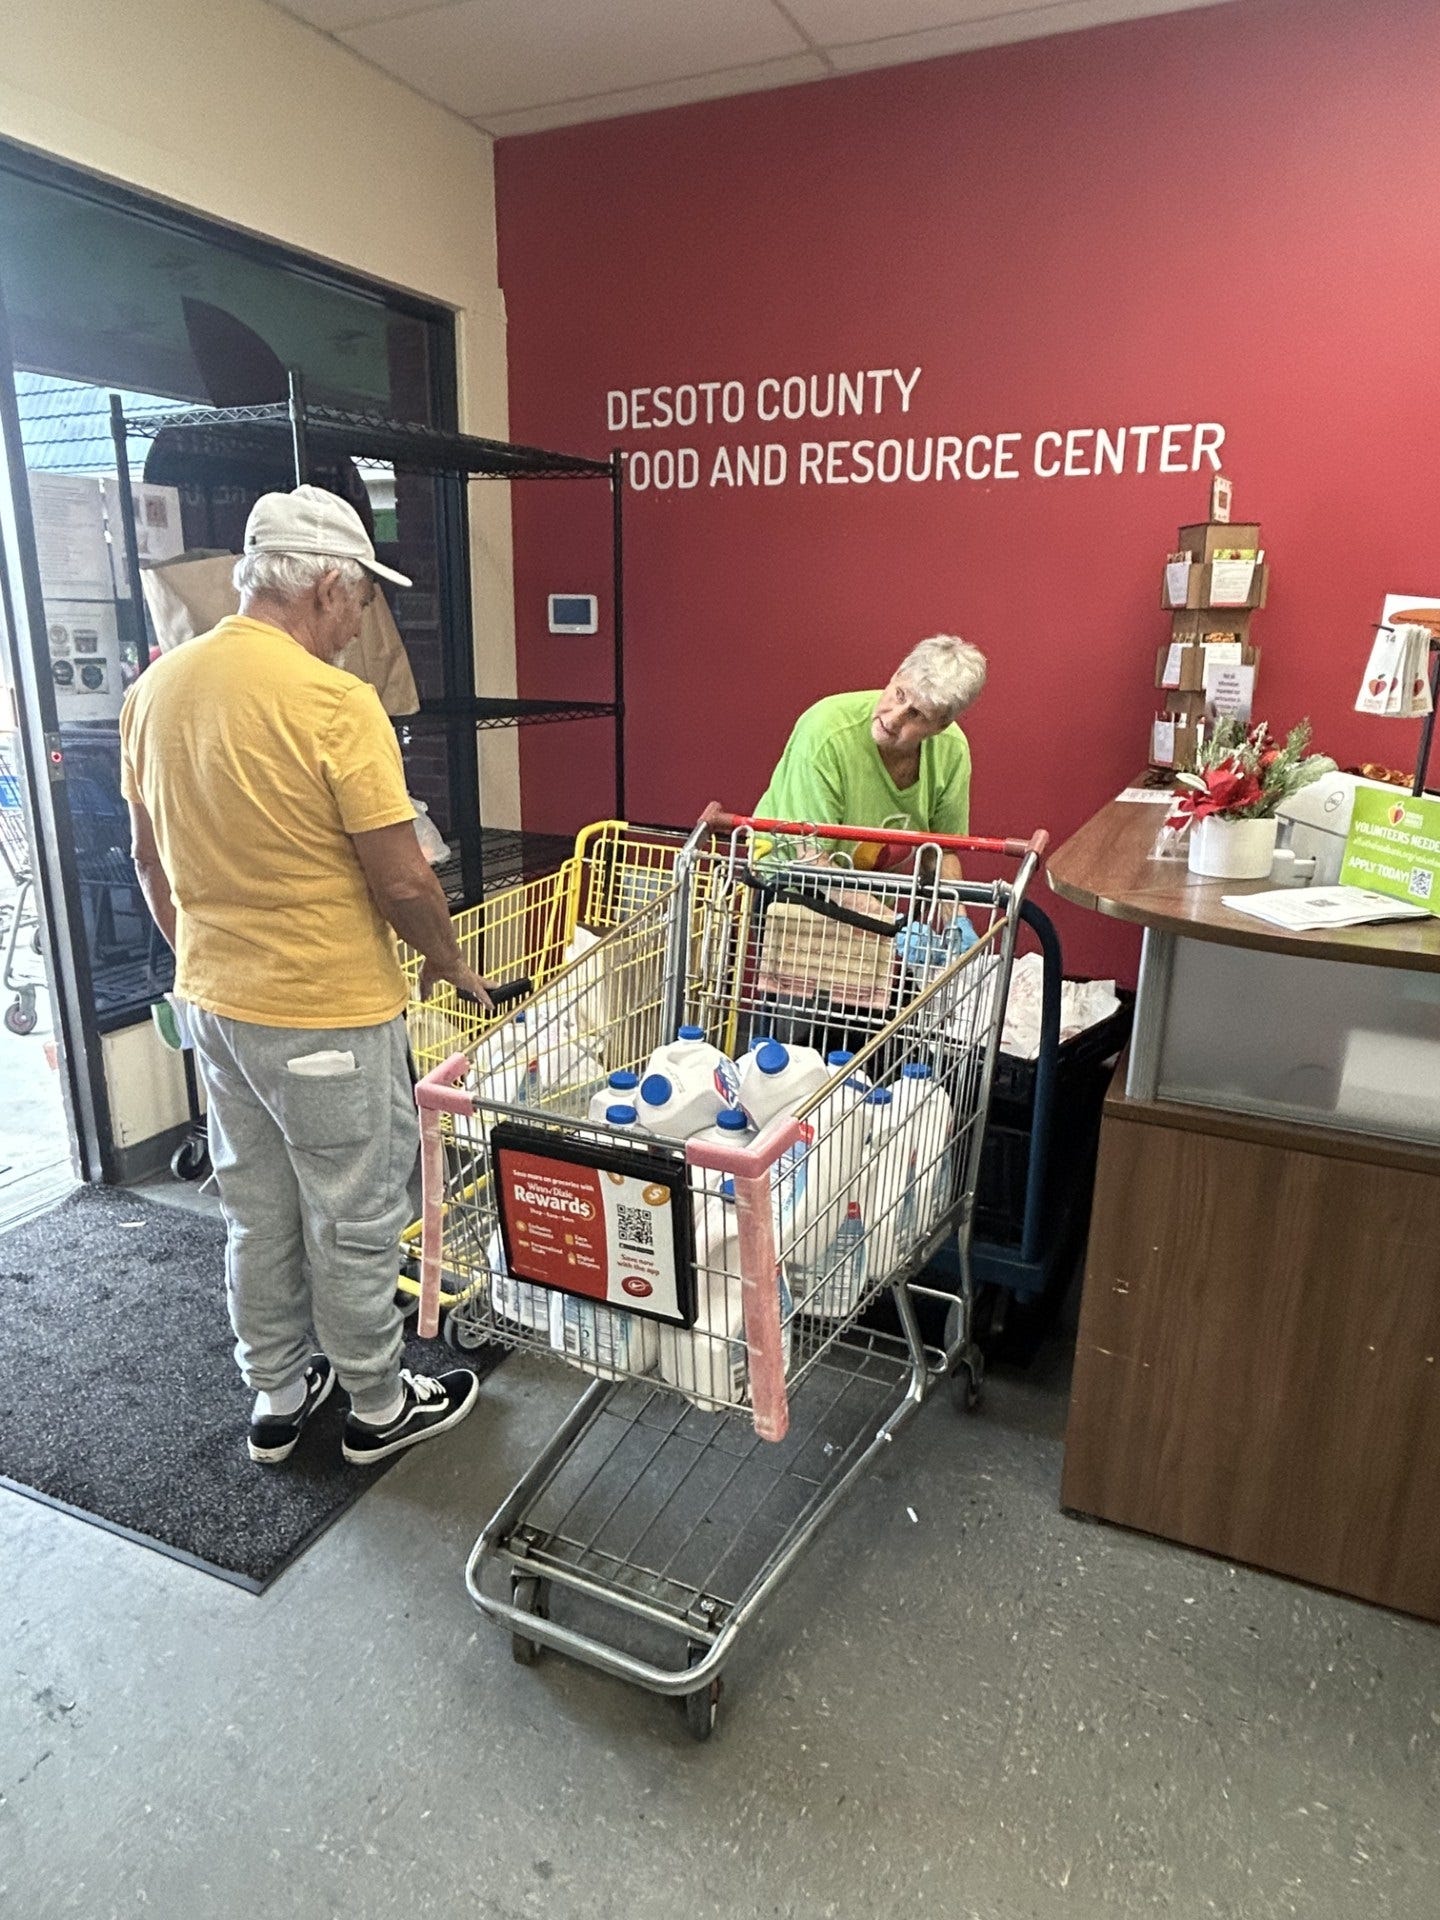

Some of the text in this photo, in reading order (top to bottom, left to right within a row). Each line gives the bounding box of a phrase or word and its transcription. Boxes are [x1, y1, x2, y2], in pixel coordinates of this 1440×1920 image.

[606, 366, 922, 431] DESOTO COUNTY
[709, 442, 788, 488] AND
[799, 431, 1022, 486] RESOURCE
[1033, 421, 1226, 481] CENTER
[1385, 634, 1397, 645] 14
[1354, 820, 1410, 845] VOLUNTEERS
[1347, 855, 1411, 884] APPLY TODAY!
